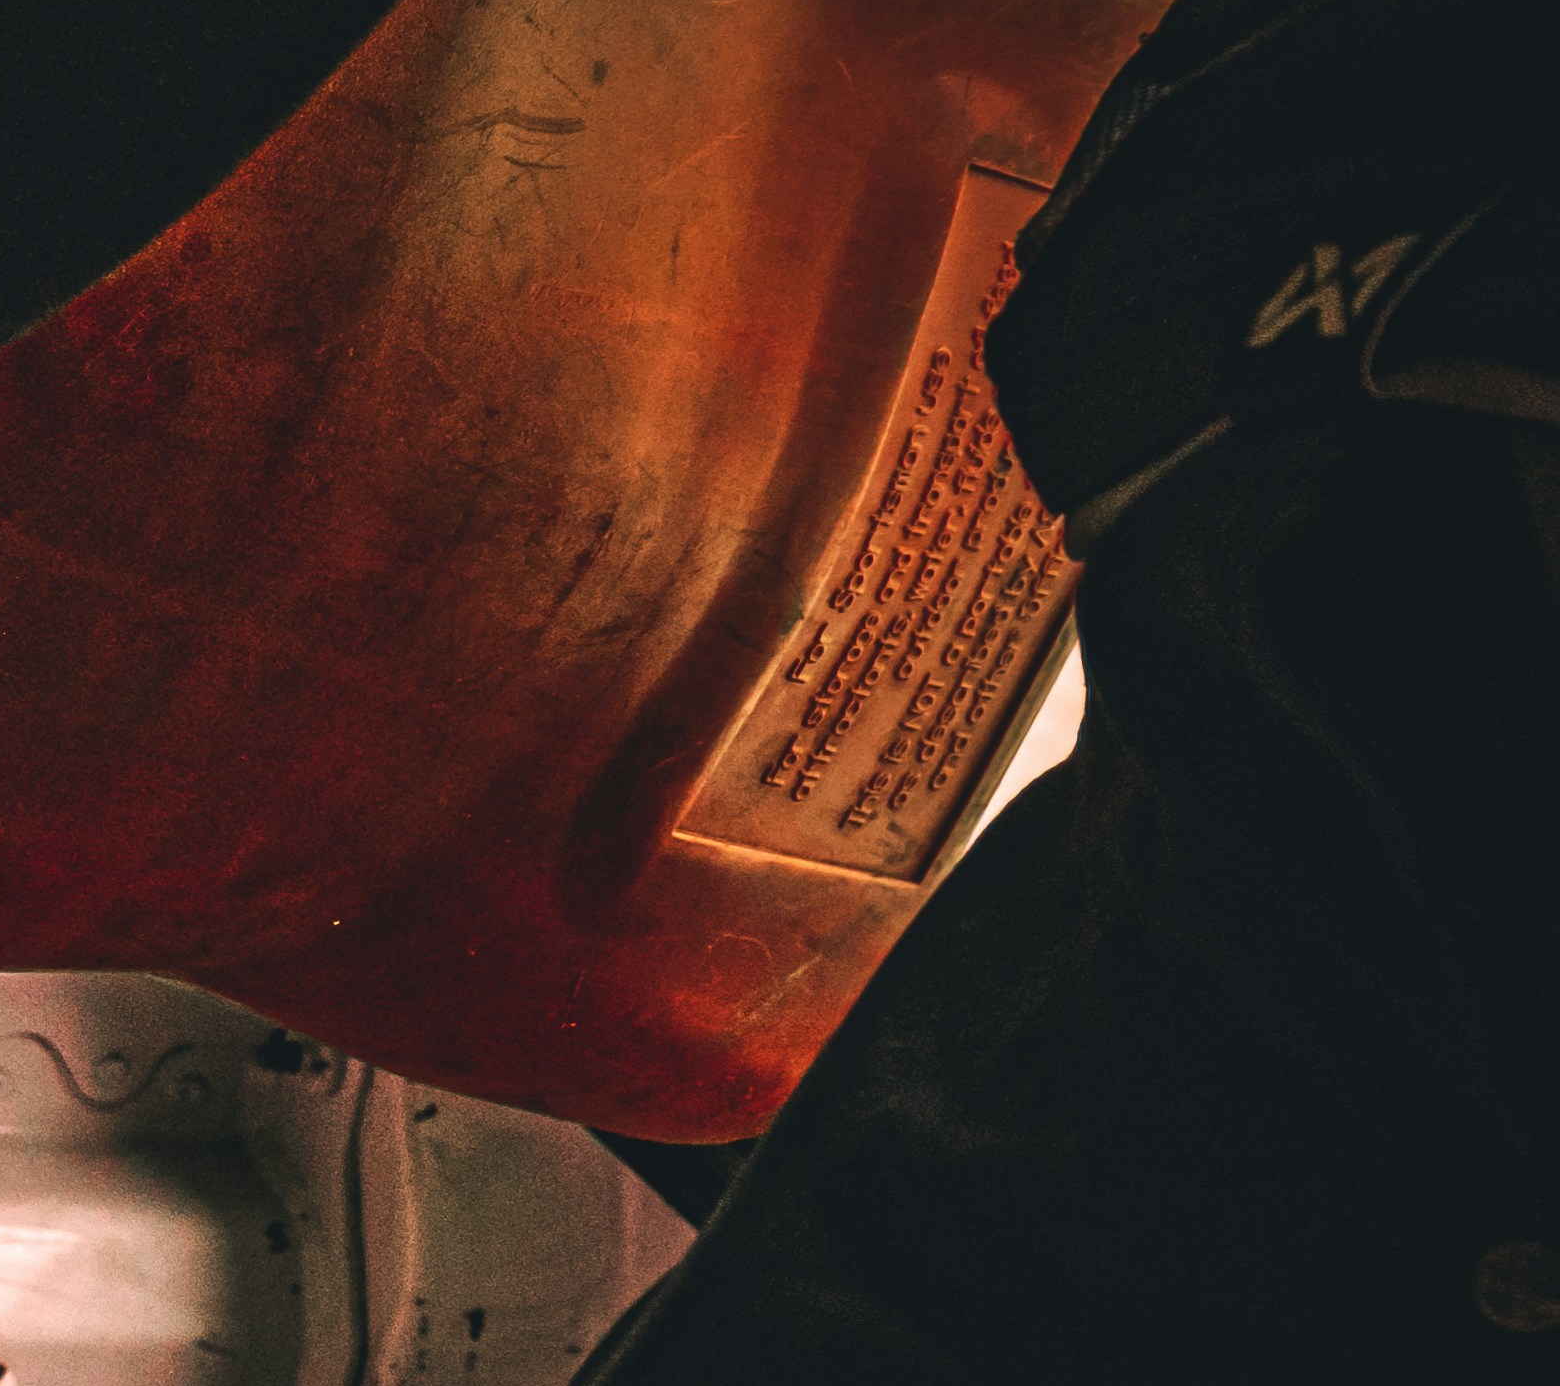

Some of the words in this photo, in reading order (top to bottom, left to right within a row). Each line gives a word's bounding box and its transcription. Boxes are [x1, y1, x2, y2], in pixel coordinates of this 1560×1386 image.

[759, 733, 804, 785] For
[800, 613, 880, 727] storage
[874, 546, 914, 601] and
[902, 377, 980, 536] transport
[782, 621, 831, 683] For
[825, 422, 929, 612] Sportsman
[841, 770, 892, 827] This
[878, 735, 912, 762] is
[898, 672, 945, 731] NOT
[940, 642, 966, 666] a
[956, 503, 1033, 636] portable
[887, 772, 921, 809] as
[914, 602, 1013, 765] described
[1001, 554, 1038, 597] by
[892, 557, 964, 680] outdoor
[926, 730, 972, 792] and
[965, 635, 1020, 725] other
